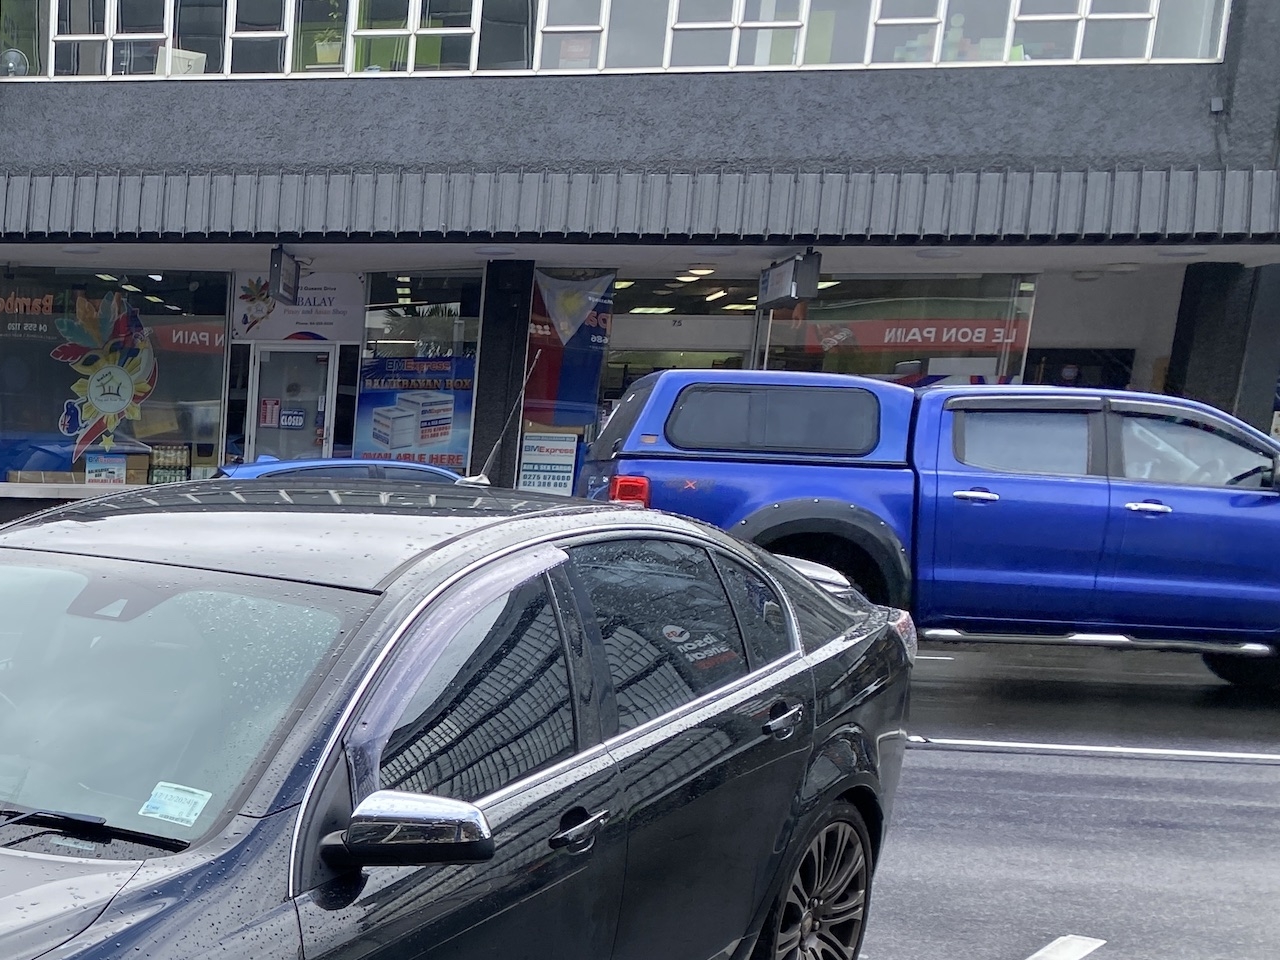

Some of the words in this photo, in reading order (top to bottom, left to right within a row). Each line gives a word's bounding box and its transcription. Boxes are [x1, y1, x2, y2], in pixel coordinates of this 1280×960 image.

[297, 296, 336, 307] BALAY
[332, 308, 348, 316] Shop
[385, 359, 451, 374] BMExpress
[364, 378, 441, 389] BALIKBAYAN
[445, 379, 472, 389] BOX
[281, 415, 304, 426] CLOSED
[524, 445, 574, 455] BMExpress
[428, 453, 464, 464] HERE
